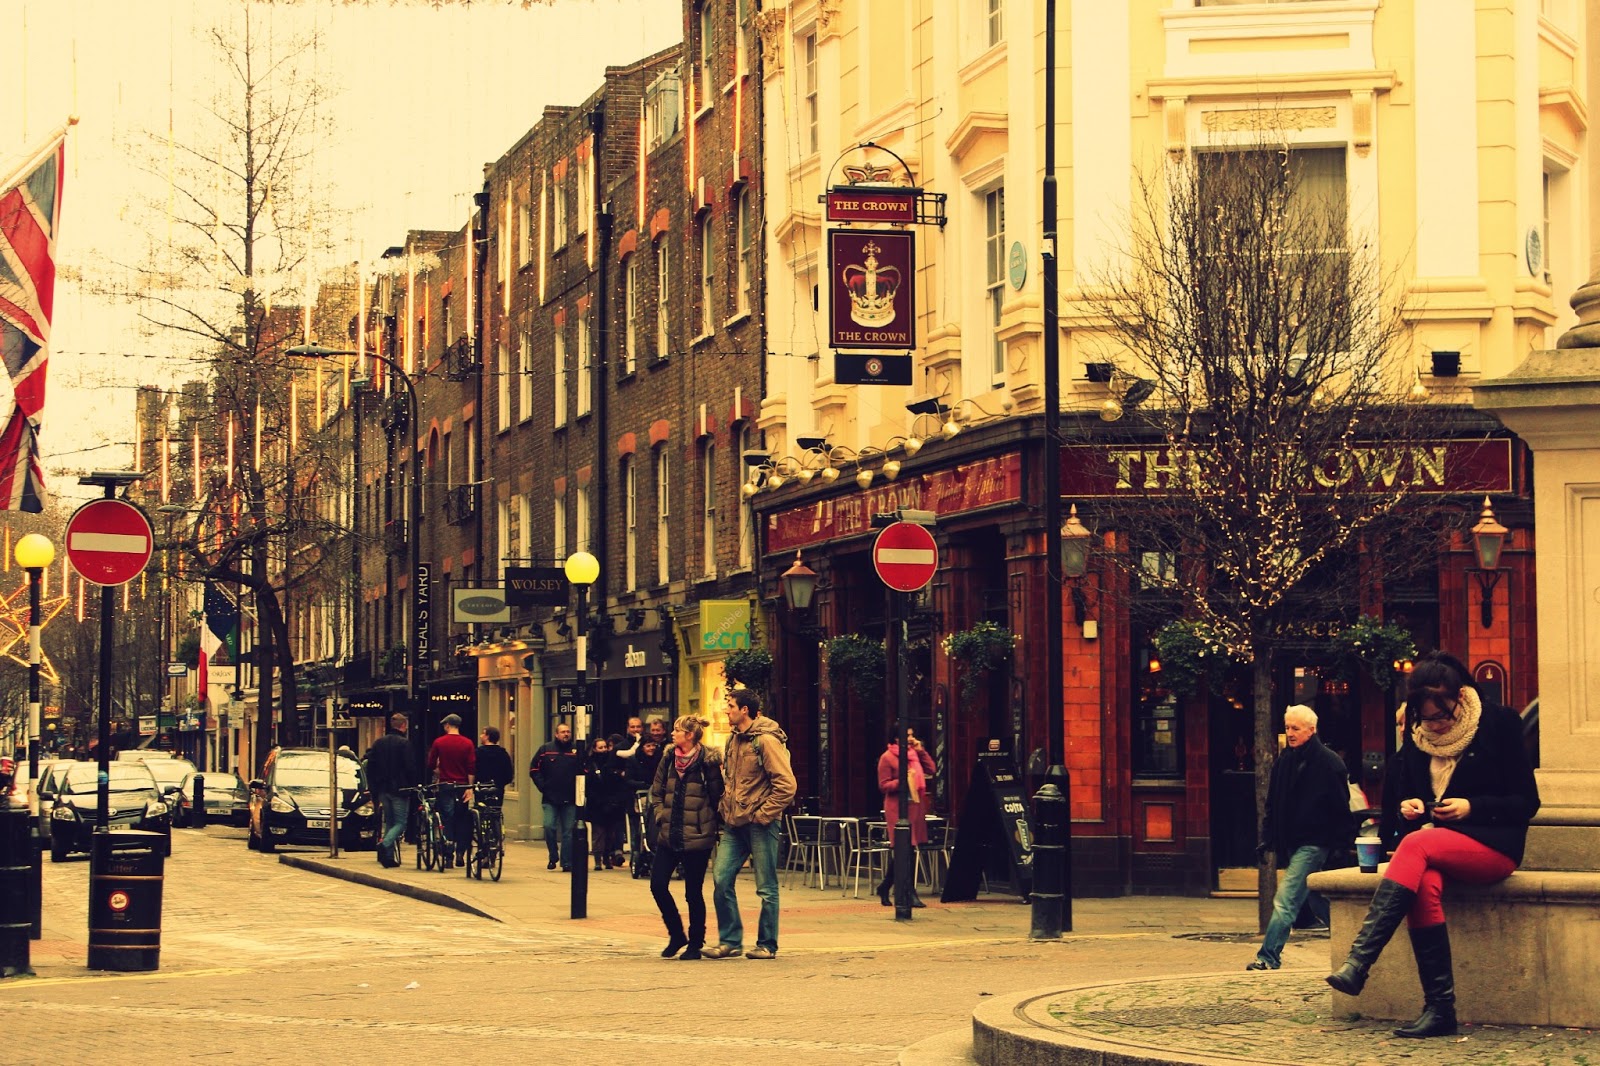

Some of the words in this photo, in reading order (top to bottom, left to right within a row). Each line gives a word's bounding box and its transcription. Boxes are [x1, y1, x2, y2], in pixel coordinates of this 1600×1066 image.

[834, 201, 859, 210] THE
[862, 202, 908, 211] CROWN
[838, 331, 861, 340] THE
[864, 332, 906, 341] CROWN
[1238, 448, 1447, 488] ROWN
[836, 498, 863, 533] THE
[418, 566, 428, 605] YARD
[511, 579, 563, 591] WOLSEY
[418, 610, 428, 660] NEAL'S
[703, 622, 750, 650] scri
[705, 607, 745, 646] scribbler
[560, 701, 594, 713] albm
